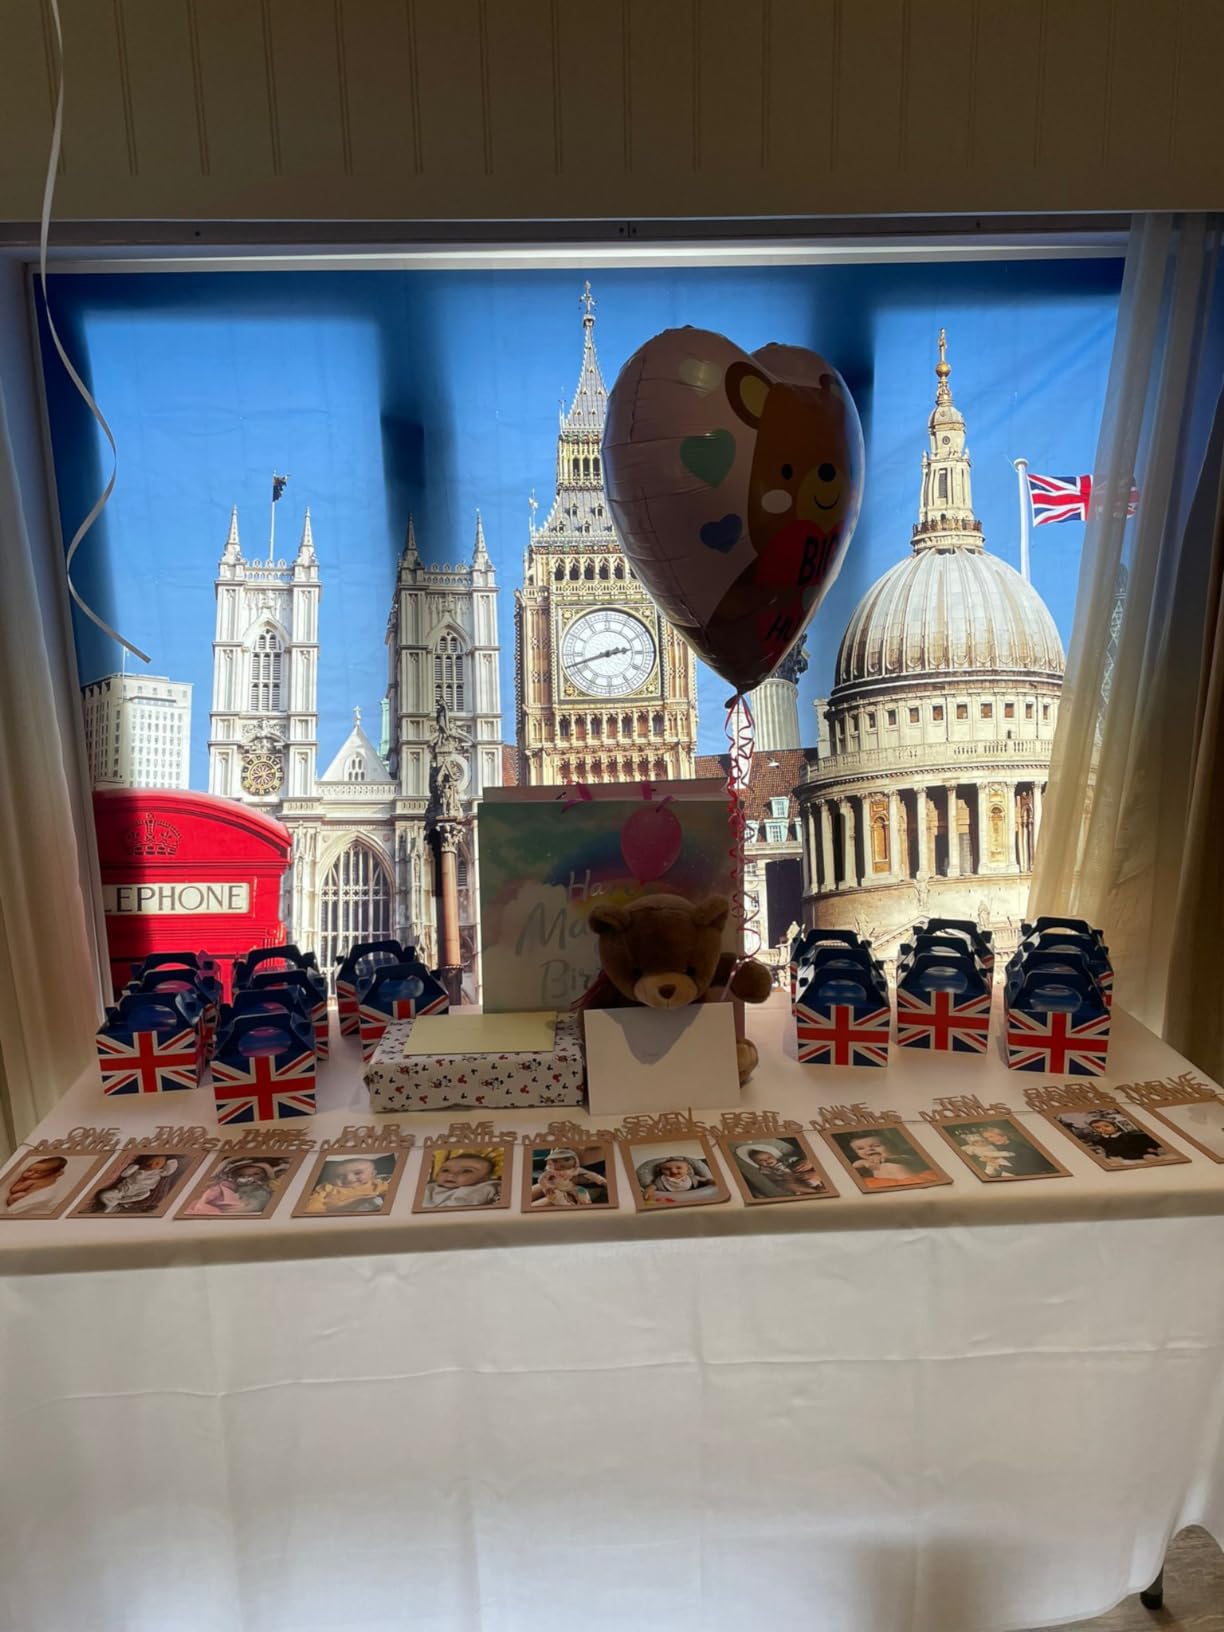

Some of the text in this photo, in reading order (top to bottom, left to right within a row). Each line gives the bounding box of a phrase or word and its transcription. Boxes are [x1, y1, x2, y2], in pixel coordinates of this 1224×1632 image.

[104, 884, 244, 913] EPHONE
[932, 1094, 981, 1110] TEN
[623, 1107, 692, 1127] SEVEN
